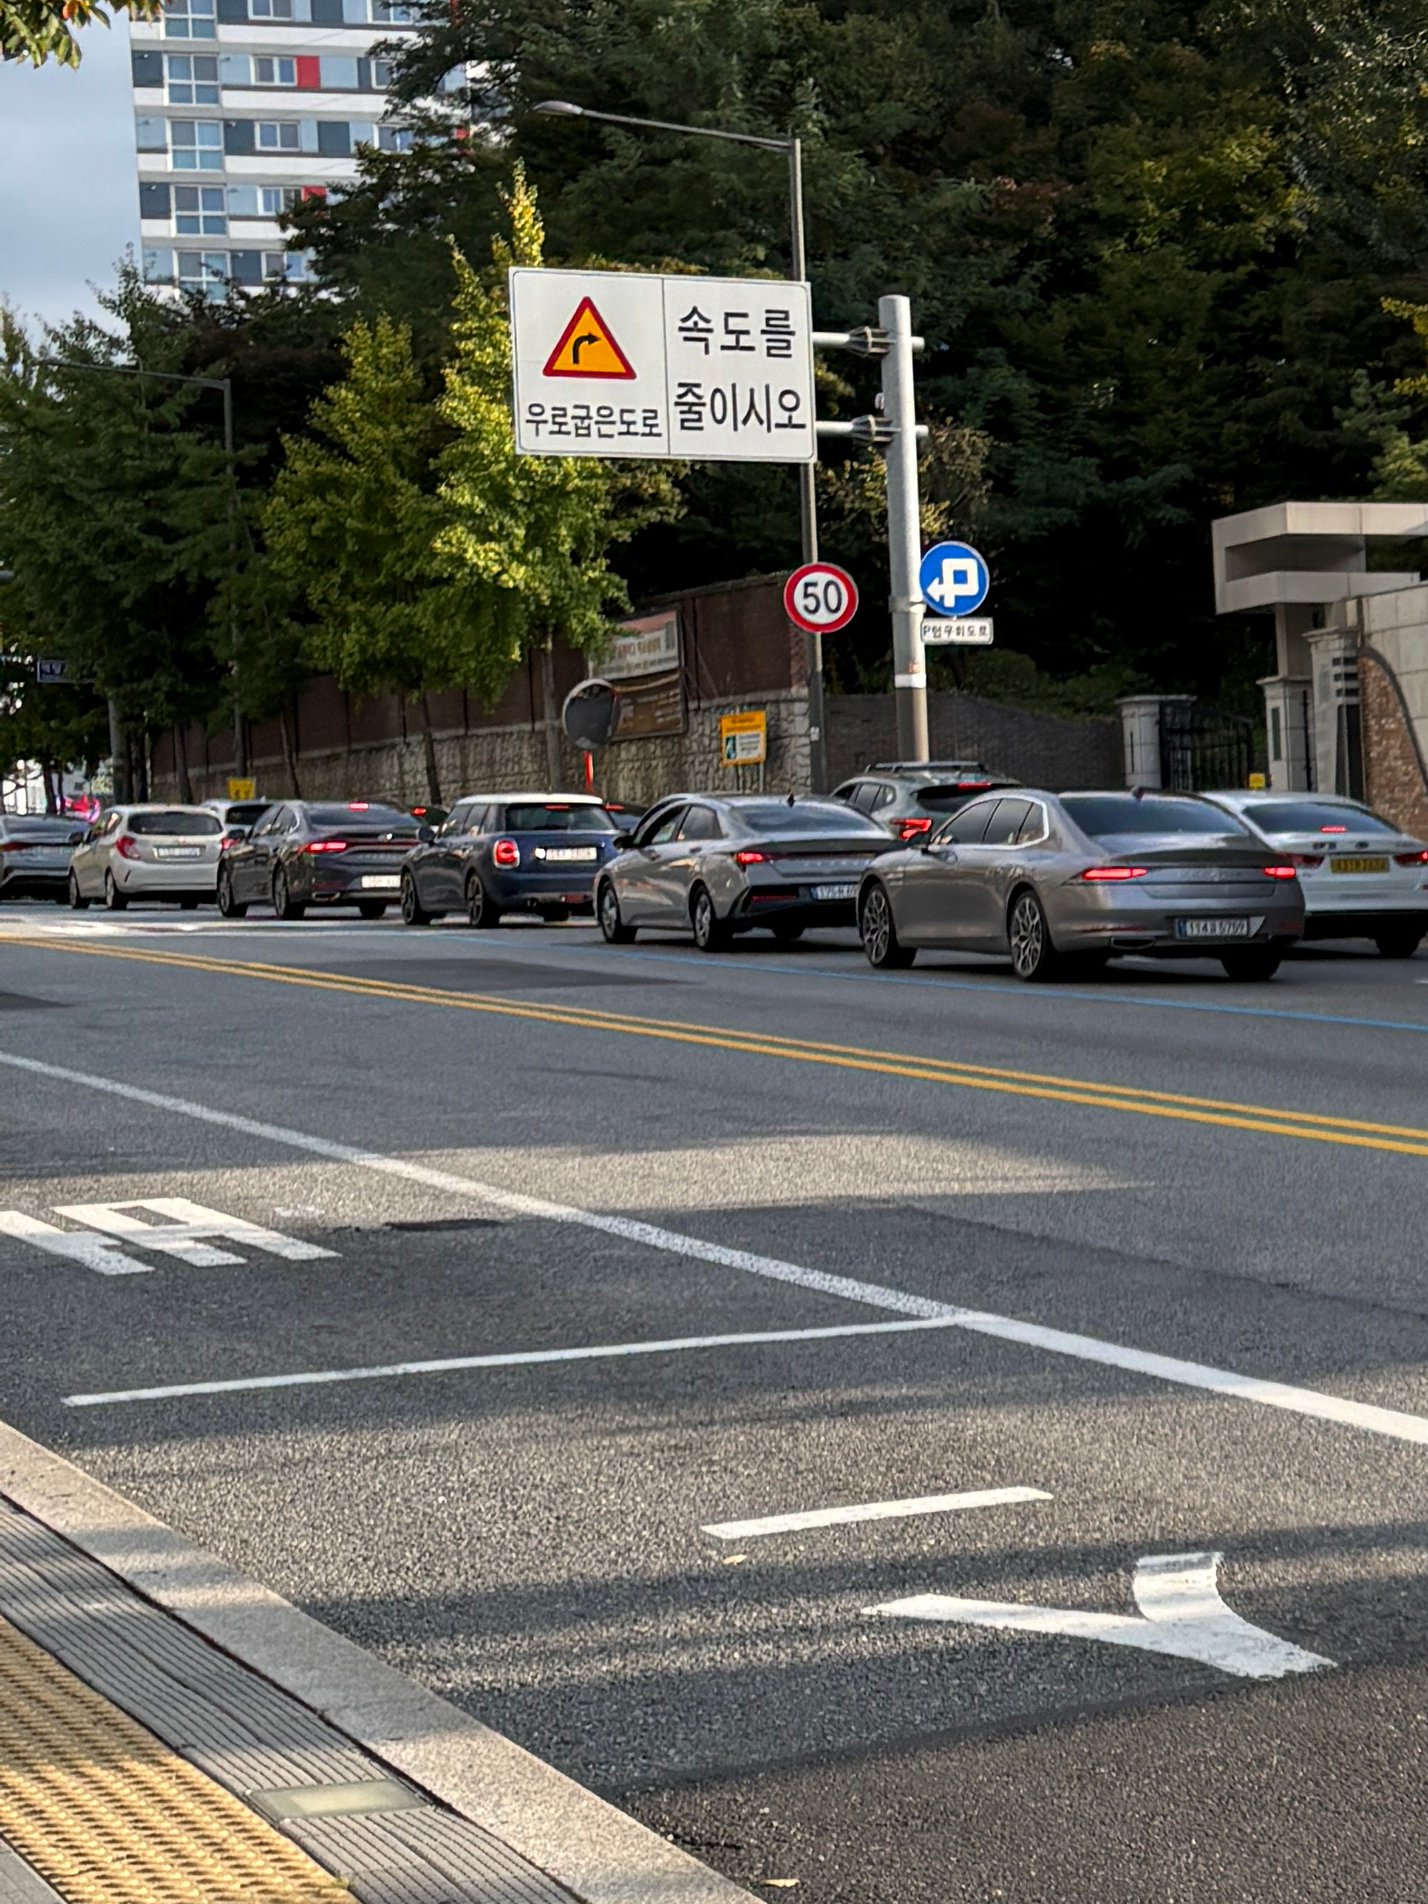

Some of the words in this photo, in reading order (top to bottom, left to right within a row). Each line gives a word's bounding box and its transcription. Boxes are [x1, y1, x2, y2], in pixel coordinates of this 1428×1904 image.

[677, 305, 797, 359] 속도를
[525, 402, 663, 439] 우로굽은도로
[674, 382, 808, 434] 줄이시오
[802, 579, 843, 615] 50
